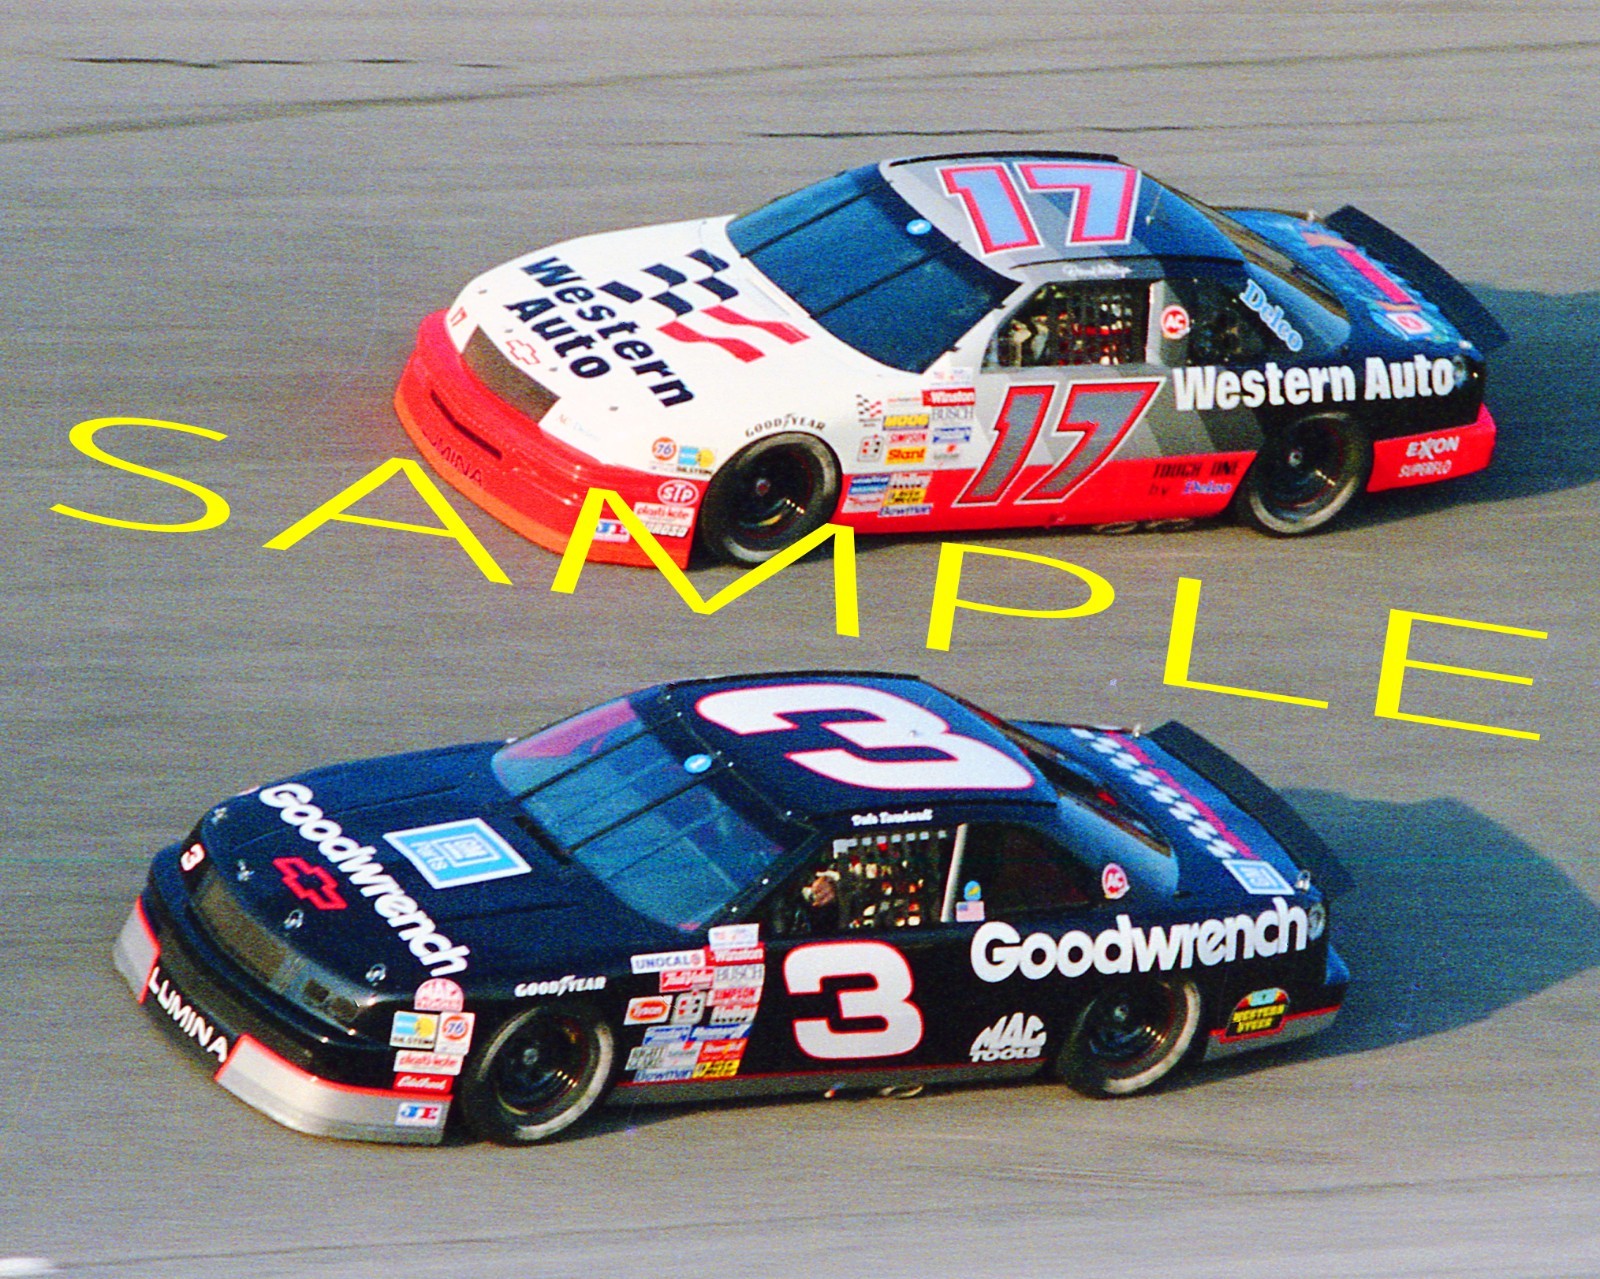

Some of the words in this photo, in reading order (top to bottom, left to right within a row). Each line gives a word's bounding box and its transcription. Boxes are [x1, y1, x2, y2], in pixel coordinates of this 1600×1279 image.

[936, 160, 1141, 258] 17
[503, 297, 611, 379] Auto
[520, 256, 696, 407] Western
[1239, 278, 1304, 352] Delco
[1173, 362, 1357, 411] Western
[1364, 354, 1454, 401] Auto
[745, 412, 826, 438] GOODYEAR
[951, 376, 1167, 507] 17
[1406, 435, 1460, 460] EXXON
[661, 484, 694, 502] STP
[694, 683, 1036, 791] 3
[180, 843, 205, 870] 3
[259, 782, 470, 977] Goodwrench
[635, 955, 689, 970] UNOCAL
[970, 896, 1308, 983] Goodwrench
[148, 966, 229, 1063] LUMINA
[514, 975, 607, 997] GOODYEAR
[783, 940, 924, 1061] 3
[969, 1012, 1047, 1056] MAC
[972, 1047, 1042, 1062] TOOLS
